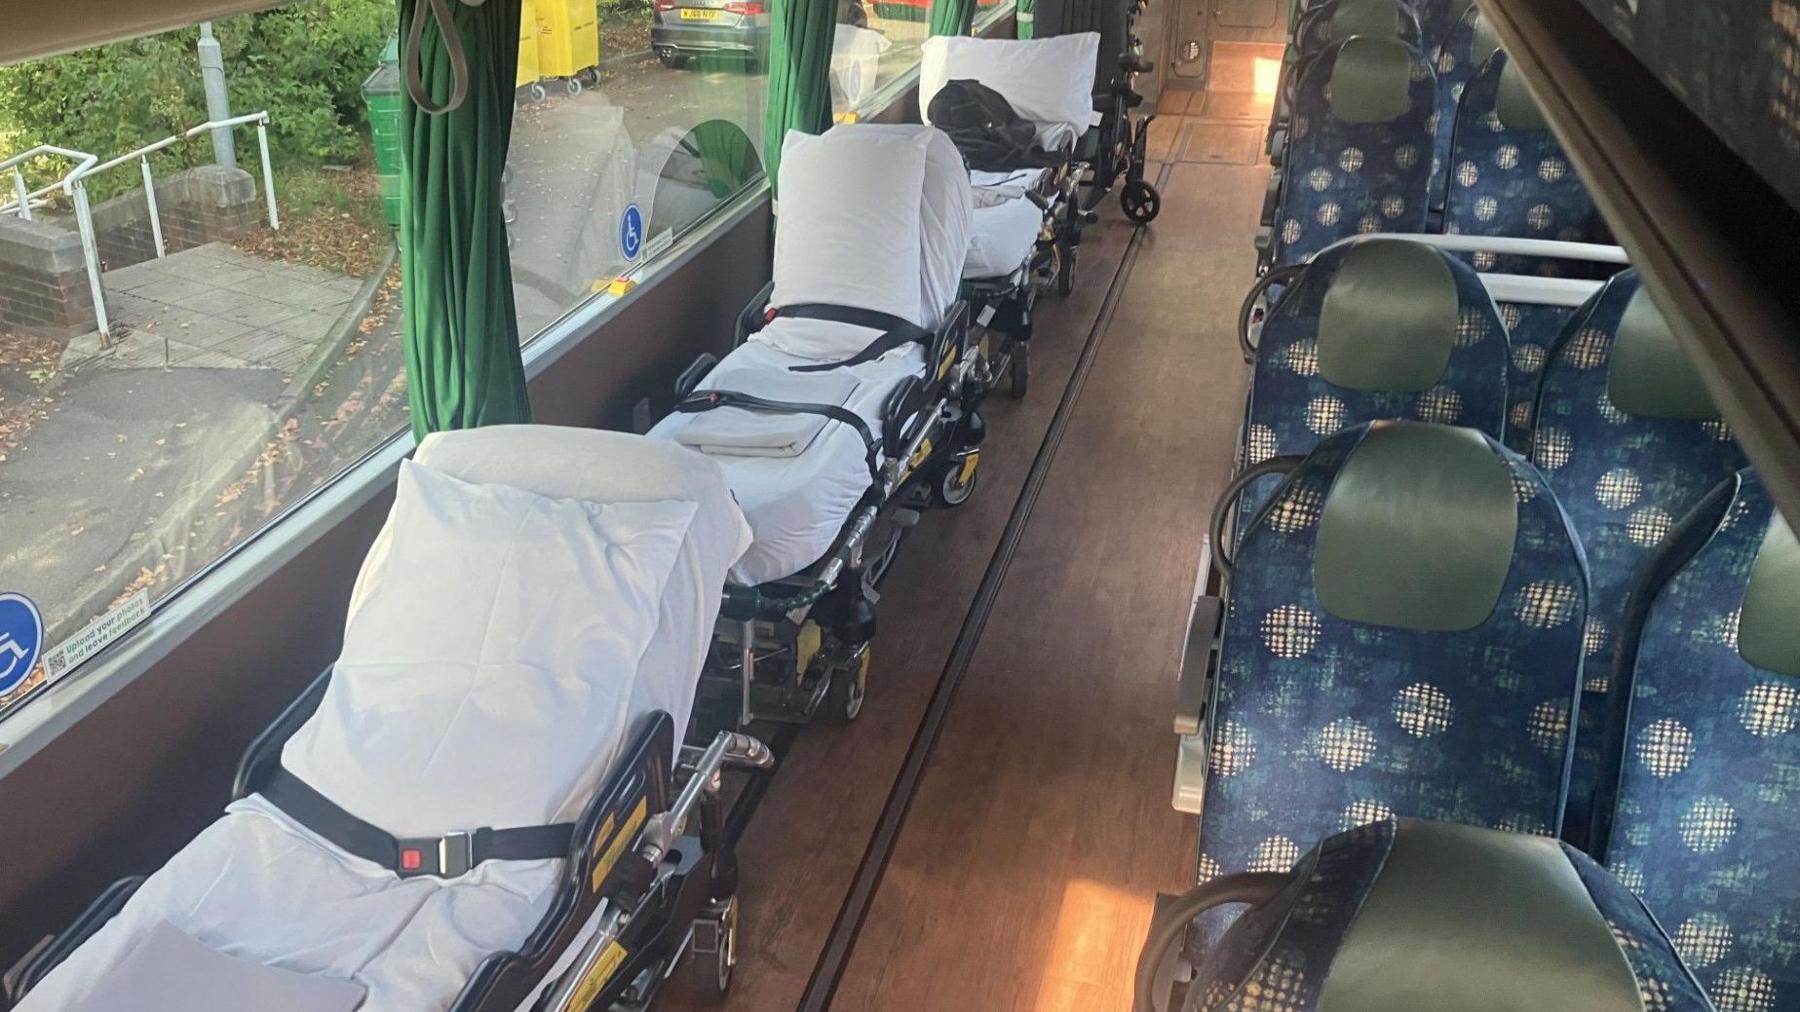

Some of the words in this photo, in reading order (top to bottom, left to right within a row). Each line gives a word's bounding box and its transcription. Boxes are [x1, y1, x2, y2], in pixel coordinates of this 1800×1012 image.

[65, 629, 96, 654] Upload
[96, 617, 115, 635] your
[116, 597, 144, 621] photos
[68, 648, 84, 664] and
[85, 634, 108, 653] leave
[109, 607, 146, 636] feedback
